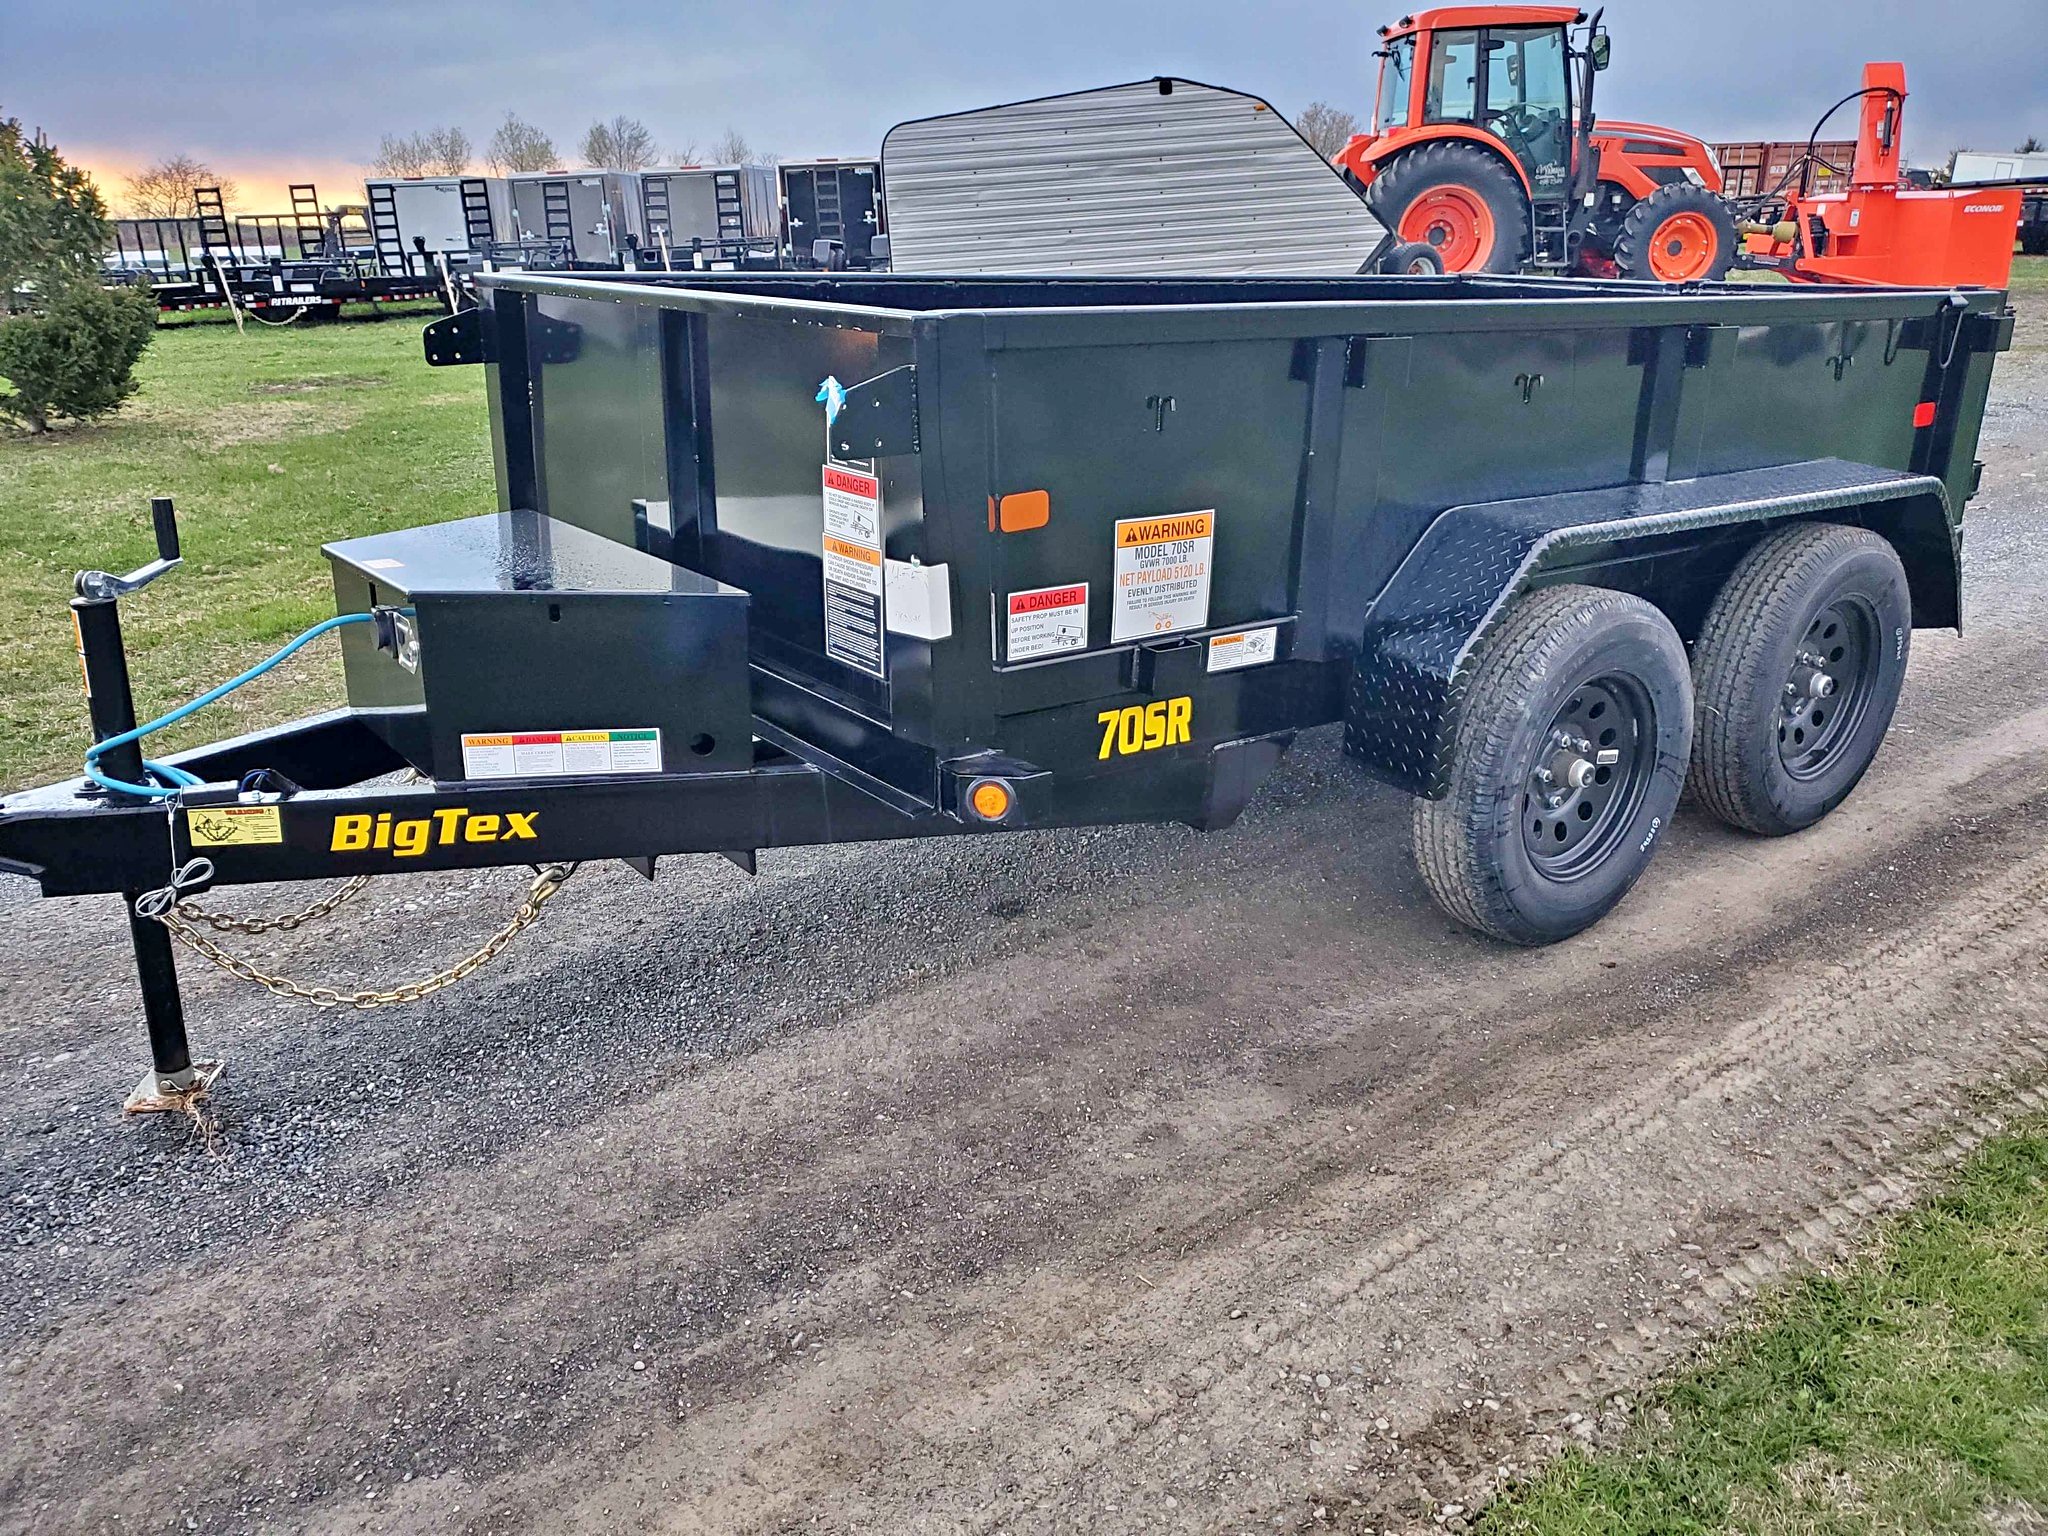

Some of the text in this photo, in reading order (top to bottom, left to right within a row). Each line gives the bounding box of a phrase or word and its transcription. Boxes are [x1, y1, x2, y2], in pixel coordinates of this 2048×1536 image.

[281, 296, 321, 306] TRAILERS
[836, 474, 870, 495] DANGER
[1139, 519, 1205, 541] WARNING
[839, 544, 871, 561] WARNING
[1135, 540, 1195, 560] MODEL 70SR
[1140, 554, 1189, 569] GVWR 7000 LB.
[1120, 563, 1206, 587] NET PAYLOAD 5120 LB.
[1128, 579, 1198, 598] EVENLY DISTRIBUTED
[1029, 591, 1077, 608] DANGER
[1011, 615, 1032, 624] SAFETY
[1033, 612, 1048, 620] PROP
[1049, 610, 1063, 618] MUST
[1020, 623, 1044, 632] POSITION
[1011, 631, 1056, 644] BEFORE WORKING
[1011, 645, 1030, 654] UNDER
[1098, 696, 1191, 760] 70SR
[468, 737, 509, 745] WARNING
[572, 734, 606, 742] CAUTION
[330, 808, 540, 857] BigTex
